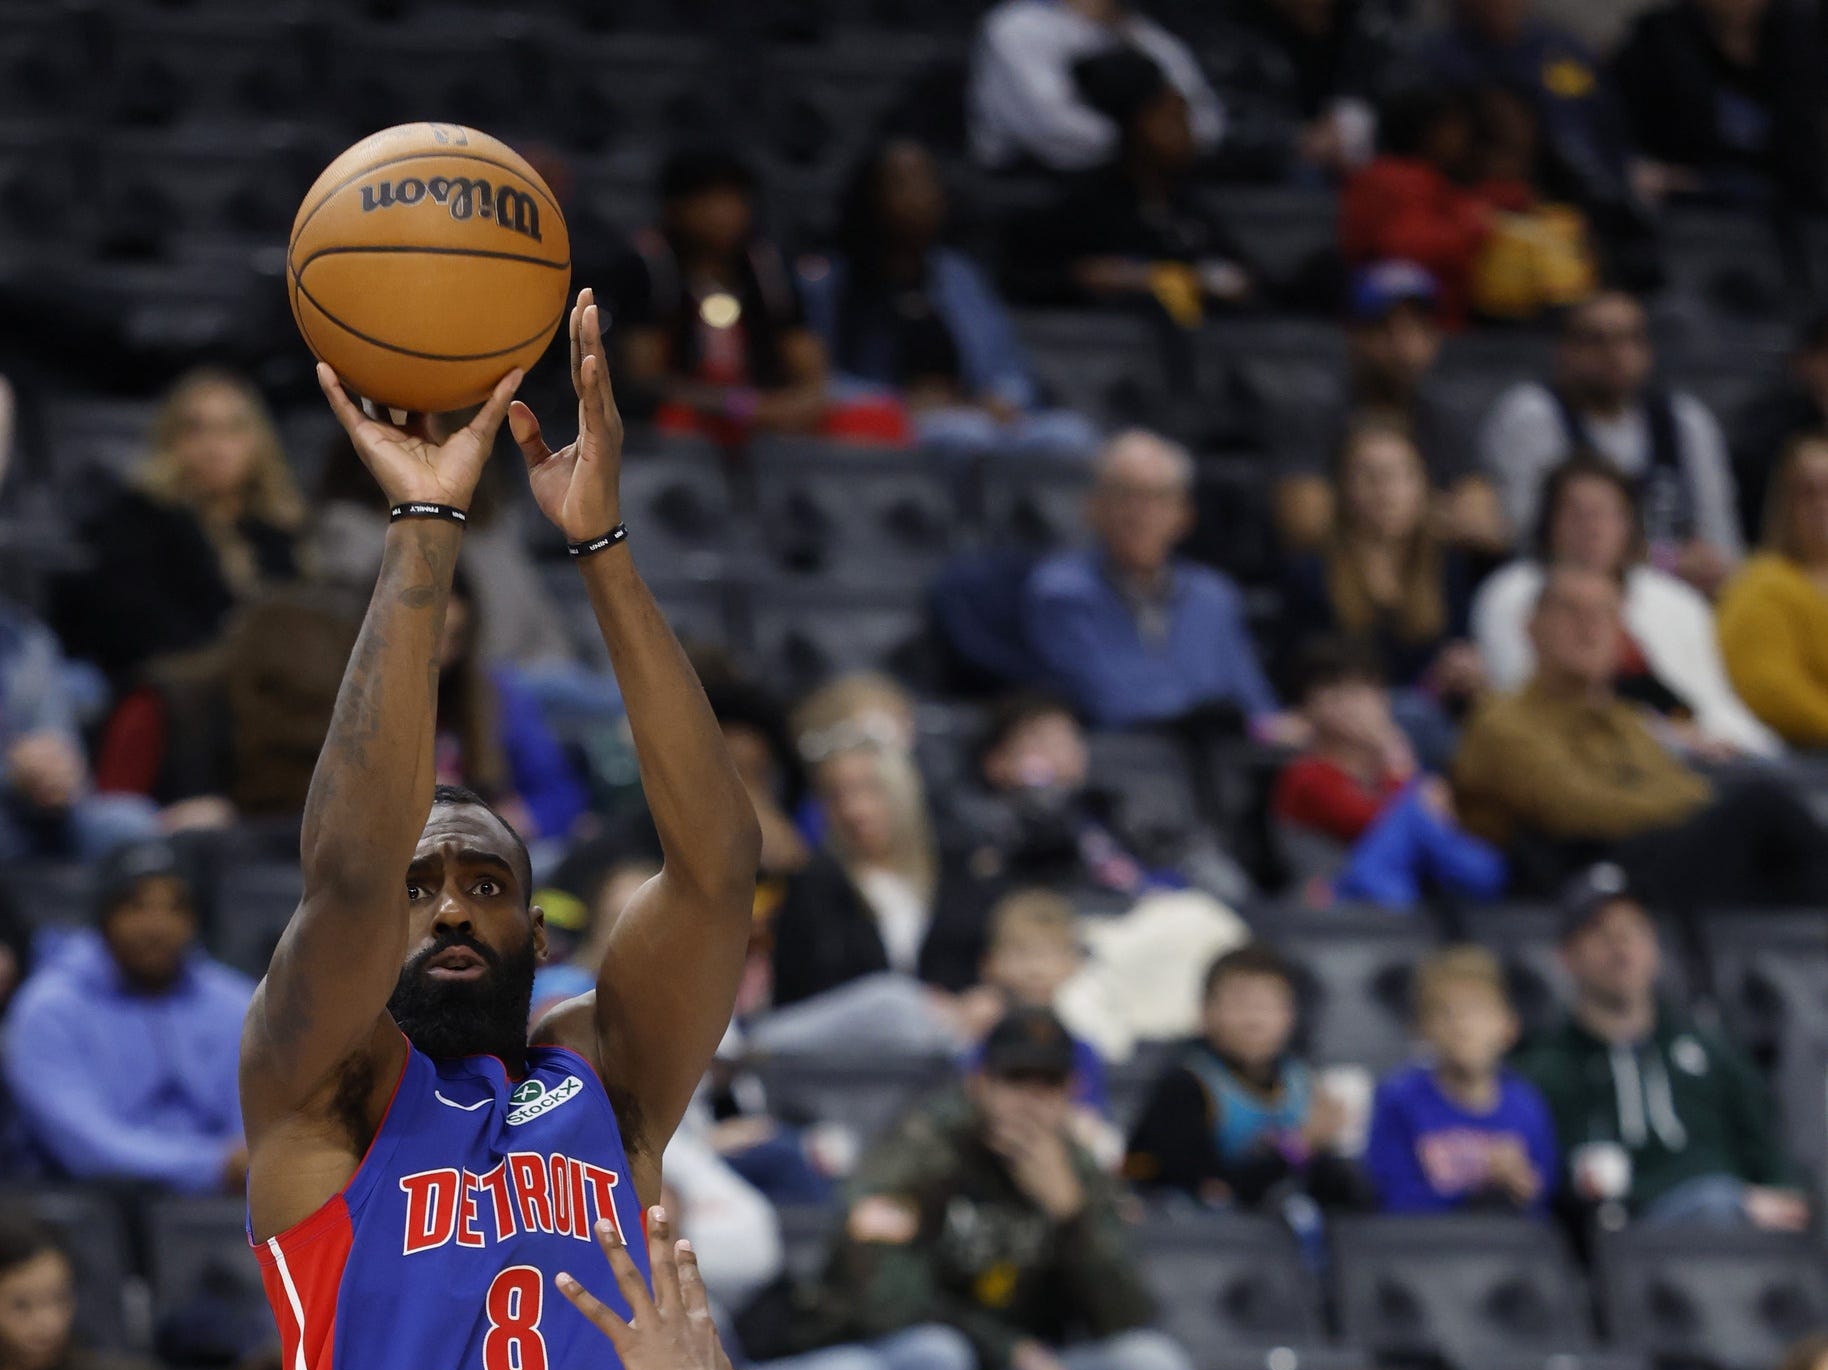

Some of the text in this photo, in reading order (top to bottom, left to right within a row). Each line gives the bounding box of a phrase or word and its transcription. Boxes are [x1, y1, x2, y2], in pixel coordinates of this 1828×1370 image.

[361, 176, 542, 243] Wilson
[507, 1078, 579, 1124] StockX
[400, 1152, 628, 1256] DETROIT
